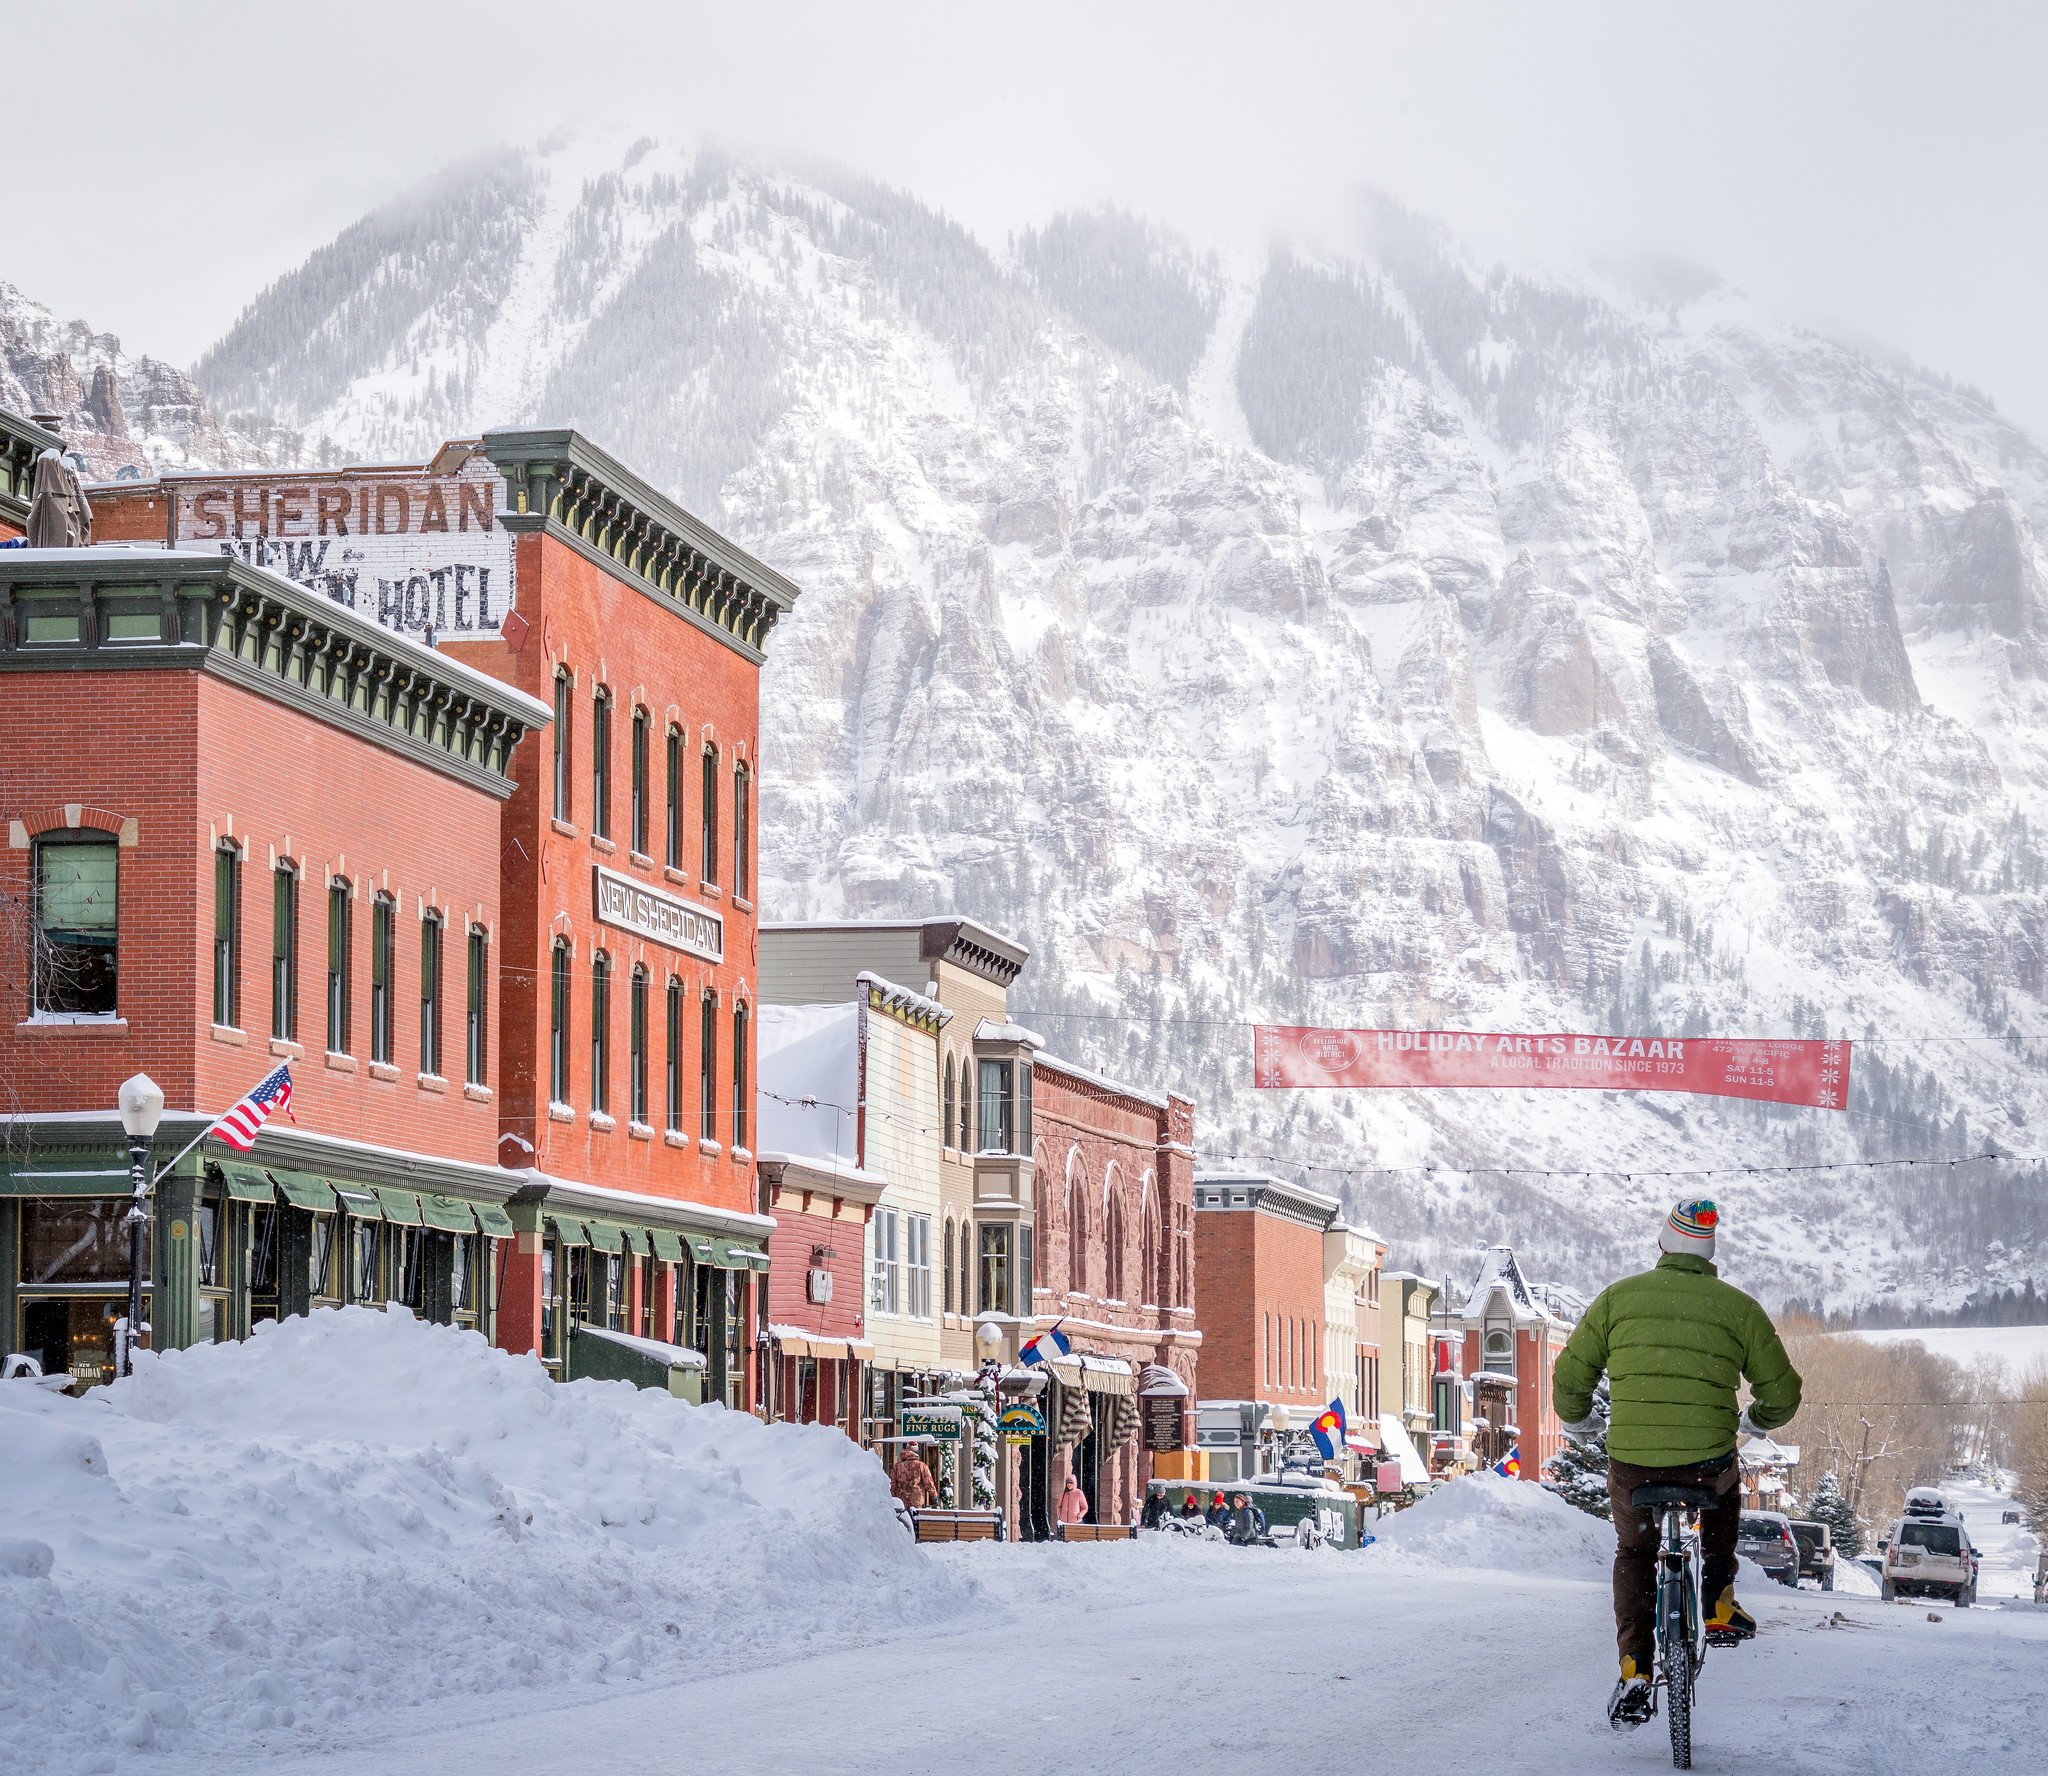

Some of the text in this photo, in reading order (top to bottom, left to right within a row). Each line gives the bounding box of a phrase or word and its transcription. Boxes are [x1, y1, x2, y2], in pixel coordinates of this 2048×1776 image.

[193, 483, 494, 539] SHERIDAN
[378, 563, 500, 632] HOTEL
[600, 878, 717, 954] NEW SHERIDAN
[1377, 1032, 1684, 1060] HOLIDAY ARTS BAZAAR
[1768, 1042, 1804, 1051] LODGE
[1712, 1046, 1733, 1054] 472
[1749, 1047, 1791, 1059] PACIFIC
[1490, 1055, 1685, 1075] A LOCAL TRADITION SINCE 1973
[1731, 1055, 1769, 1065] FRI 4-8
[1726, 1064, 1774, 1076] SAT 11-5
[1725, 1074, 1774, 1086] SUN 11-5
[68, 1367, 101, 1378] SHERIDAN
[905, 1424, 957, 1433] FINE RUGS
